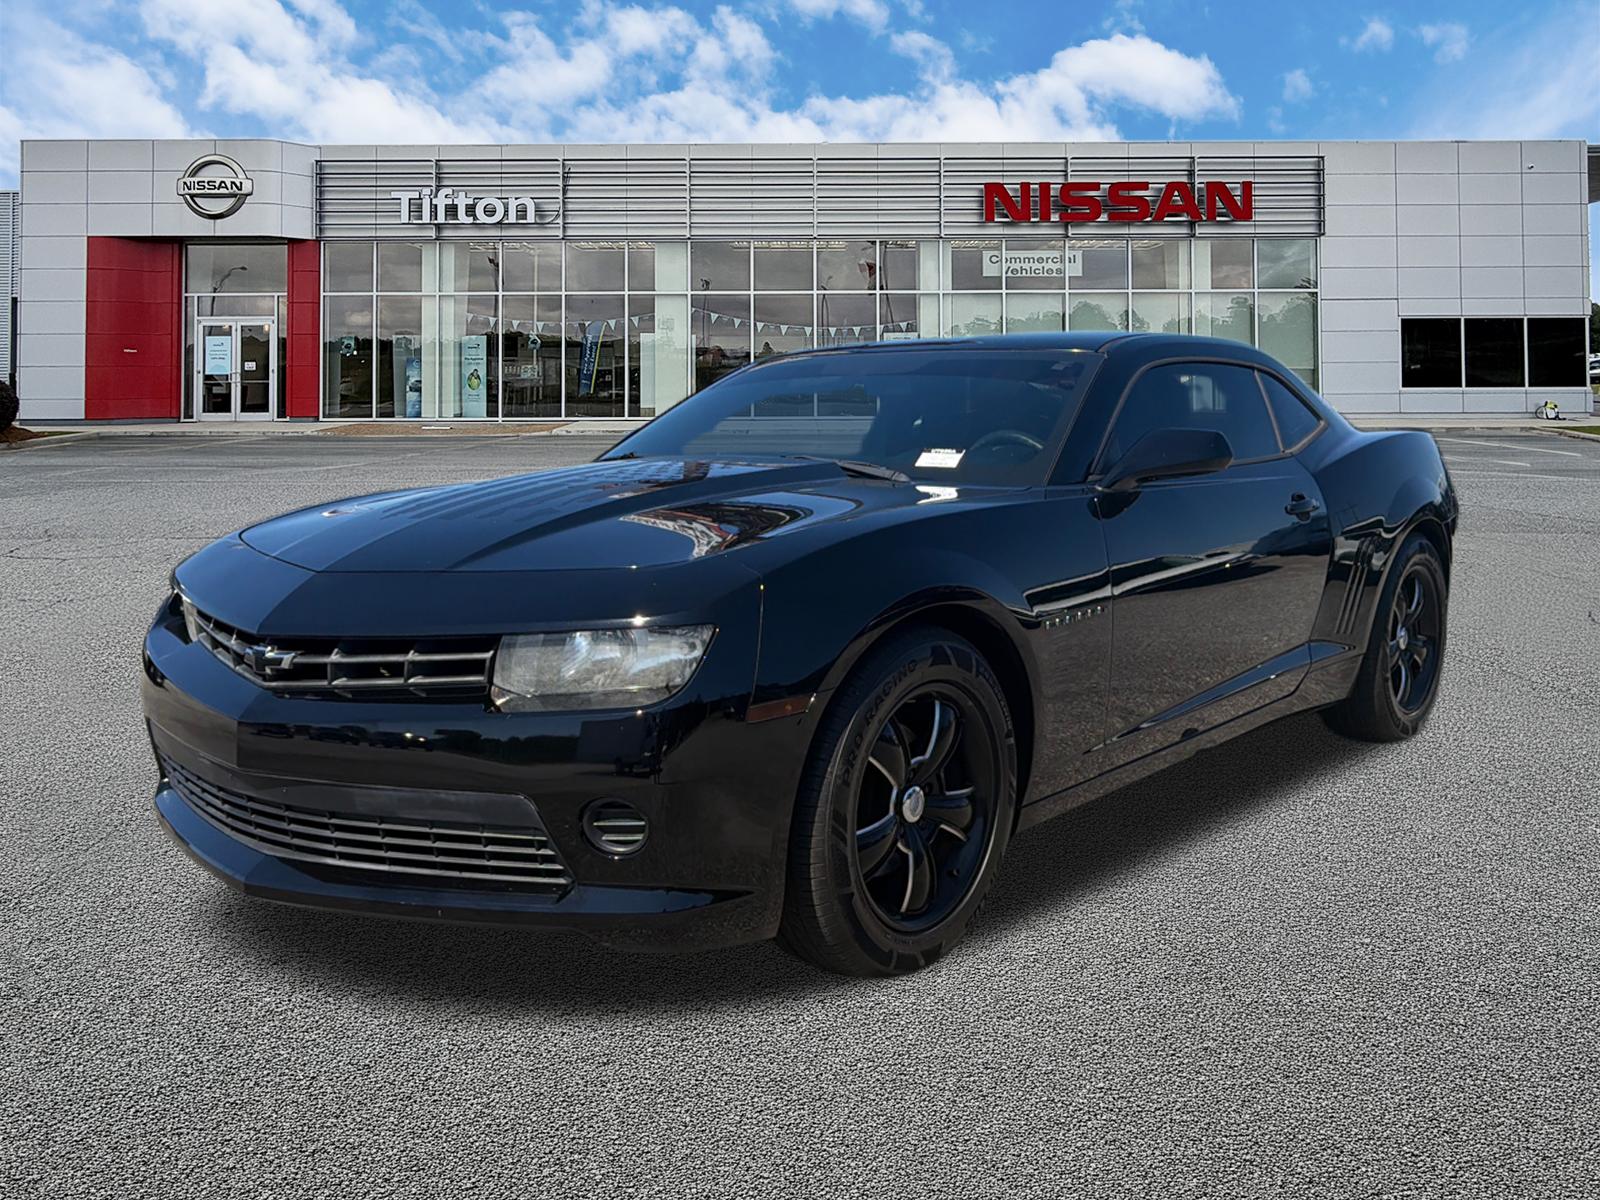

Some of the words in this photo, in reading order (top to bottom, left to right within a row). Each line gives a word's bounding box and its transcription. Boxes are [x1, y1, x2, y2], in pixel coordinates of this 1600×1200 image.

[182, 180, 243, 192] NISSAN
[983, 181, 1254, 222] NISSAN
[390, 187, 536, 225] Tifton
